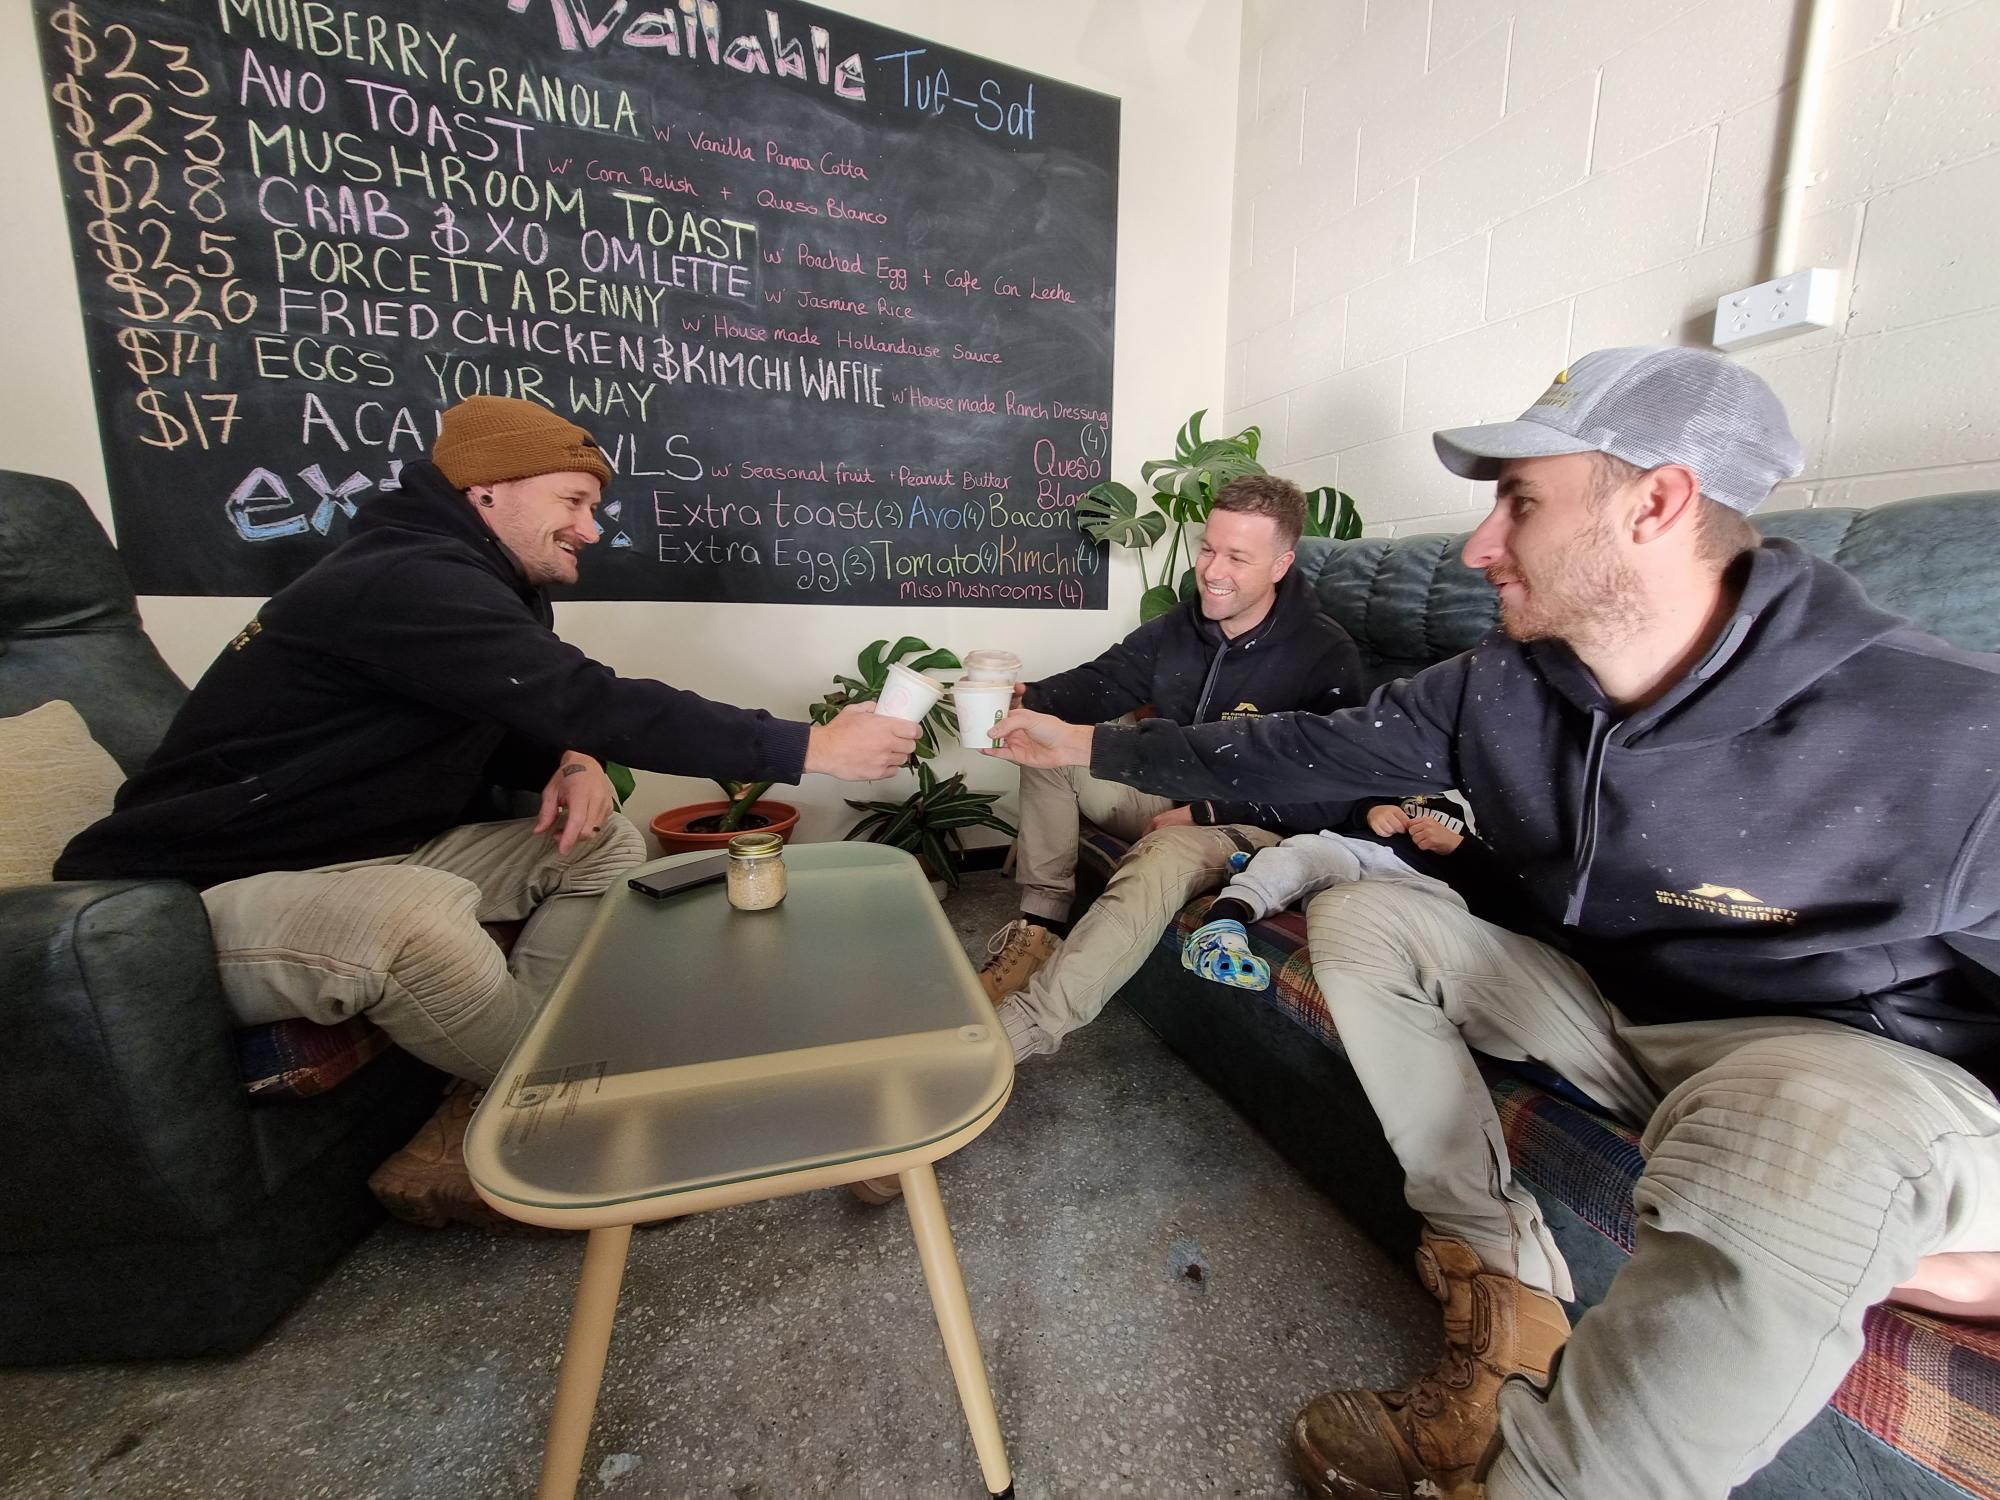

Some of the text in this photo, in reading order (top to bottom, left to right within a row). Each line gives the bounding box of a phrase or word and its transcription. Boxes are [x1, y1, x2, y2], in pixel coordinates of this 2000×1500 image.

[50, 2, 210, 98] $23
[51, 73, 225, 167] $23
[240, 47, 535, 172] AVO TOAST
[453, 58, 639, 137] GRANOLA
[687, 131, 756, 162] Vanilla
[766, 140, 815, 172] Panna
[820, 151, 869, 181] Cotta
[74, 150, 227, 225] $28
[246, 118, 756, 260] MUSHROOM TOAST
[586, 160, 632, 185] Corn
[640, 166, 699, 197] Relish
[756, 189, 818, 215] Queso
[826, 198, 888, 225] Blanco
[87, 218, 237, 278] $25
[258, 175, 410, 240] CRAB
[485, 212, 549, 266] XO
[581, 228, 751, 297] OMLETTE
[106, 271, 257, 330] $26
[798, 243, 866, 275] Poached
[876, 256, 907, 290] Egg
[944, 268, 982, 296] Cafe
[994, 276, 1020, 297] Con
[1030, 277, 1076, 303] Leche
[797, 291, 869, 316] Jasmine
[877, 297, 914, 319] Rice
[117, 327, 217, 384] $14
[280, 287, 440, 340] FRIED
[451, 309, 645, 374] CHICKEN
[681, 342, 791, 392] KIMCHI
[714, 315, 767, 342] House
[774, 326, 821, 346] made
[837, 329, 941, 358] Hollandaise
[952, 343, 1003, 364] Sauce
[254, 336, 658, 423] EGGS YOUR WAY
[136, 387, 243, 451] $17
[957, 394, 997, 416] made
[1005, 390, 1048, 420] Ranch
[1053, 401, 1109, 430] Dressing
[1033, 438, 1101, 481] Queso
[1080, 423, 1107, 459] (4)
[740, 460, 829, 483] Seasonal
[834, 461, 876, 485] fruit
[900, 465, 956, 487] Peanut
[962, 471, 1012, 492] Butter
[653, 490, 762, 529] Extra
[658, 533, 761, 565] Extra
[946, 580, 1054, 601] Mushrooms
